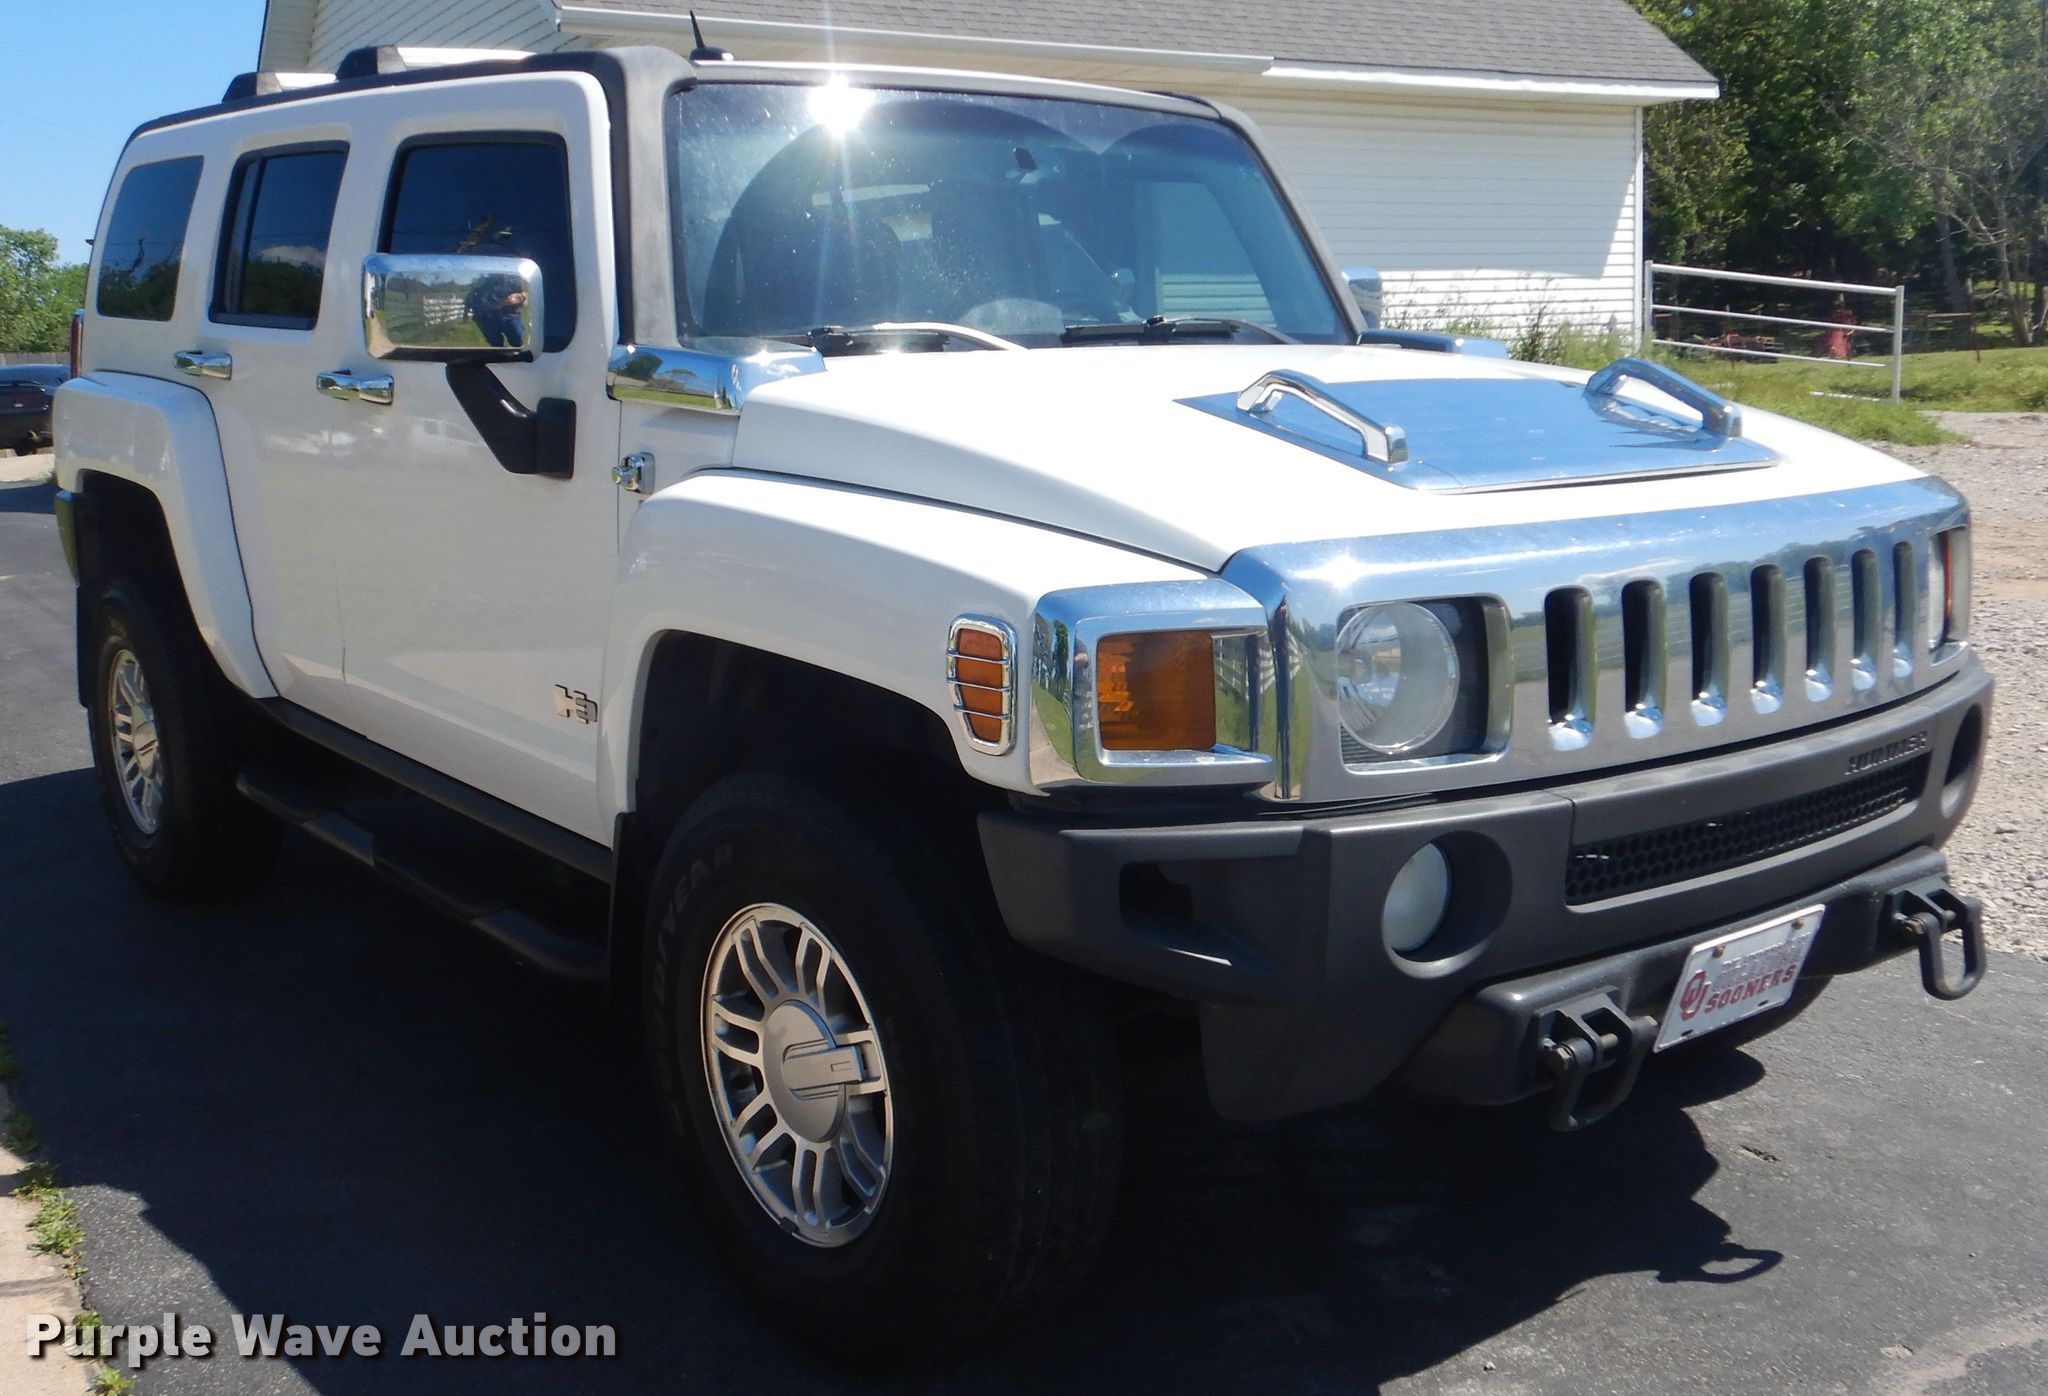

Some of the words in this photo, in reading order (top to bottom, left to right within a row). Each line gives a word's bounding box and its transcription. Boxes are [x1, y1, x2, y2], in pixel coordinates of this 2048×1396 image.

[554, 684, 598, 724] H3
[1845, 731, 1928, 776] HUMMER
[1704, 964, 1798, 1013] SOONERS
